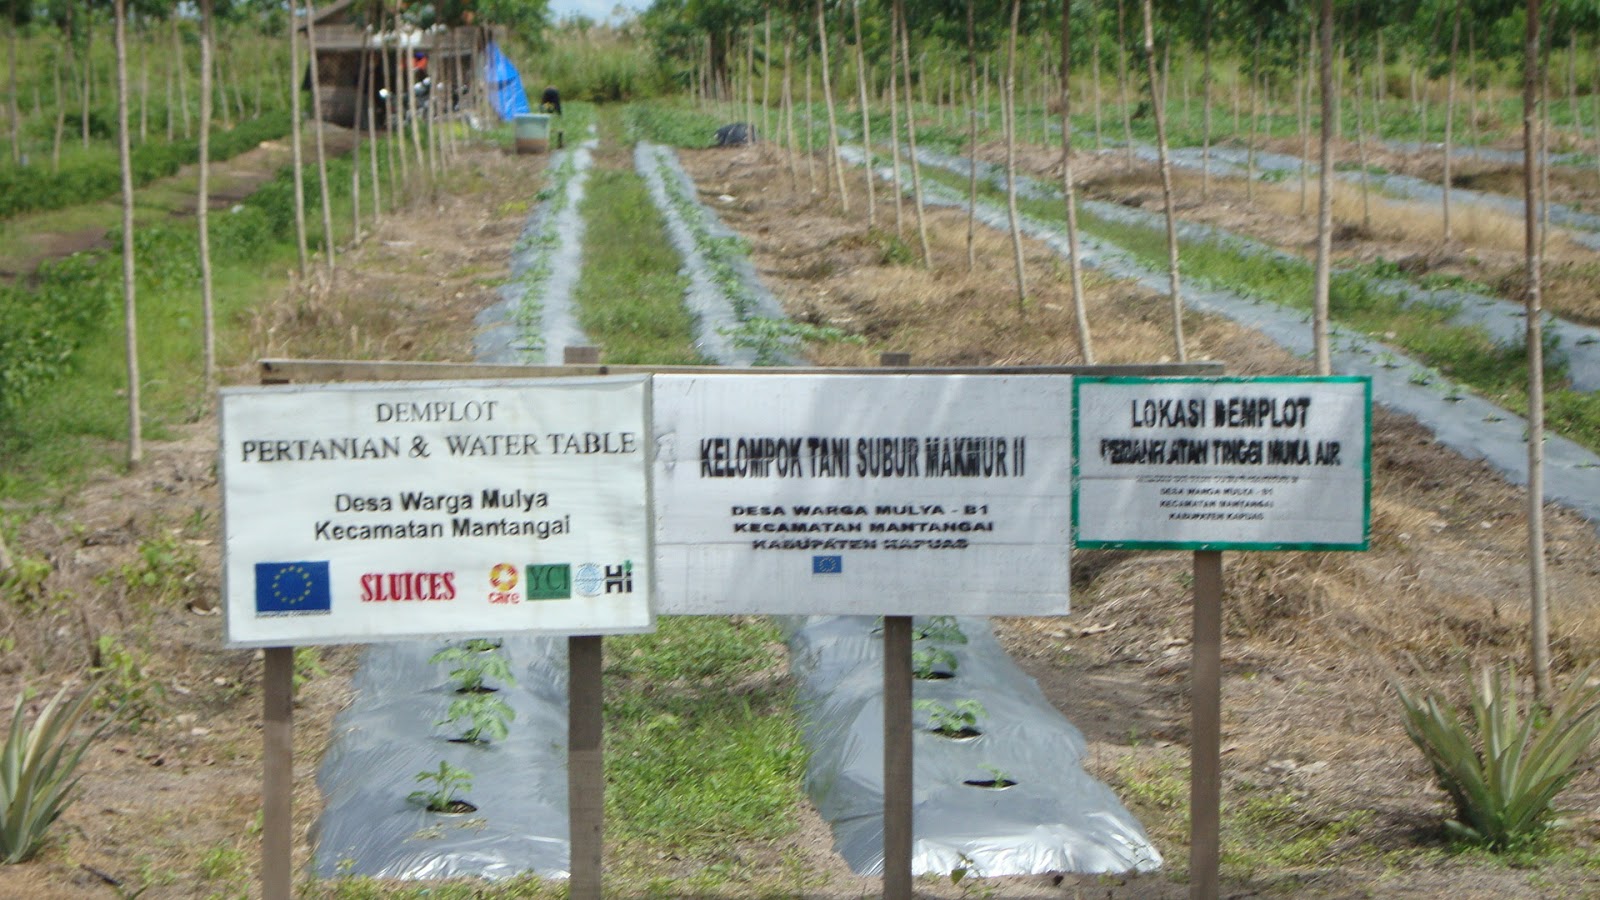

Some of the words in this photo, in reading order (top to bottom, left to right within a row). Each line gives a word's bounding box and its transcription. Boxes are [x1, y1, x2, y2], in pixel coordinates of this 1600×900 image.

[375, 400, 499, 424] DEMPLOT
[1132, 399, 1206, 428] LOKASI
[1214, 397, 1312, 428] DEMPLOT
[241, 438, 400, 463] PERTANIAN
[408, 434, 431, 459] &
[446, 432, 540, 457] WATER
[547, 432, 637, 456] TABLE
[701, 437, 802, 478] KELOMPOK
[808, 437, 850, 478] TANI
[856, 436, 918, 477] SUBUR
[924, 435, 1007, 478] MAKMUR
[1013, 436, 1026, 477] II
[335, 493, 392, 512] Desa
[400, 491, 474, 514] Warga
[481, 489, 549, 512] Mulya
[731, 506, 786, 516] DESA
[793, 506, 868, 516] WARGA
[876, 505, 945, 516] MULYA
[964, 505, 989, 515] B1
[315, 520, 443, 540] Kecamatan
[452, 514, 571, 539] Mantangai
[734, 523, 862, 532] KECAMATAN
[870, 522, 993, 532] MANTANGAI
[752, 540, 877, 549] KABUPATEN
[360, 572, 456, 602] SLUICES
[528, 565, 570, 592] YCI
[488, 592, 520, 605] care
